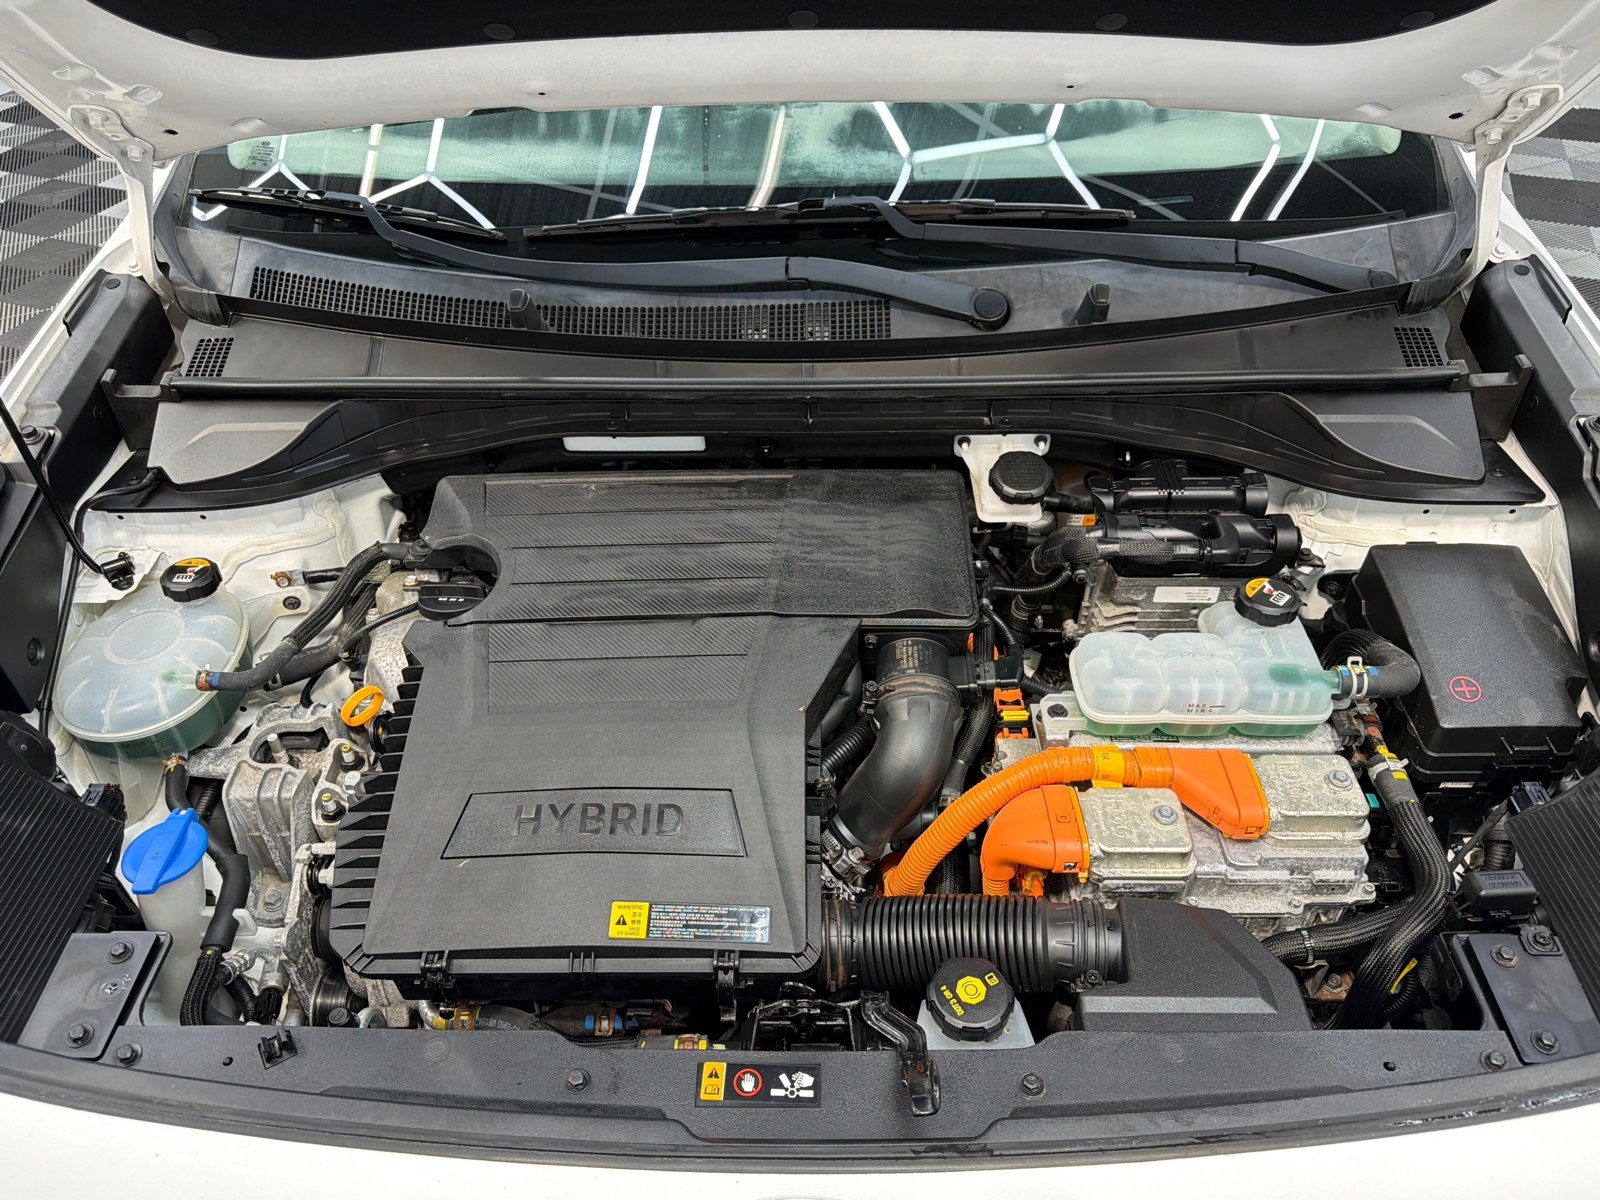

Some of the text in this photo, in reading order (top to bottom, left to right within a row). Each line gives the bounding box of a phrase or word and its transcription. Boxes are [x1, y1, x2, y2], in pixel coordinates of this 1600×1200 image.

[511, 802, 684, 837] HYBRID
[943, 989, 953, 999] OR
[949, 998, 965, 1016] DOT3
